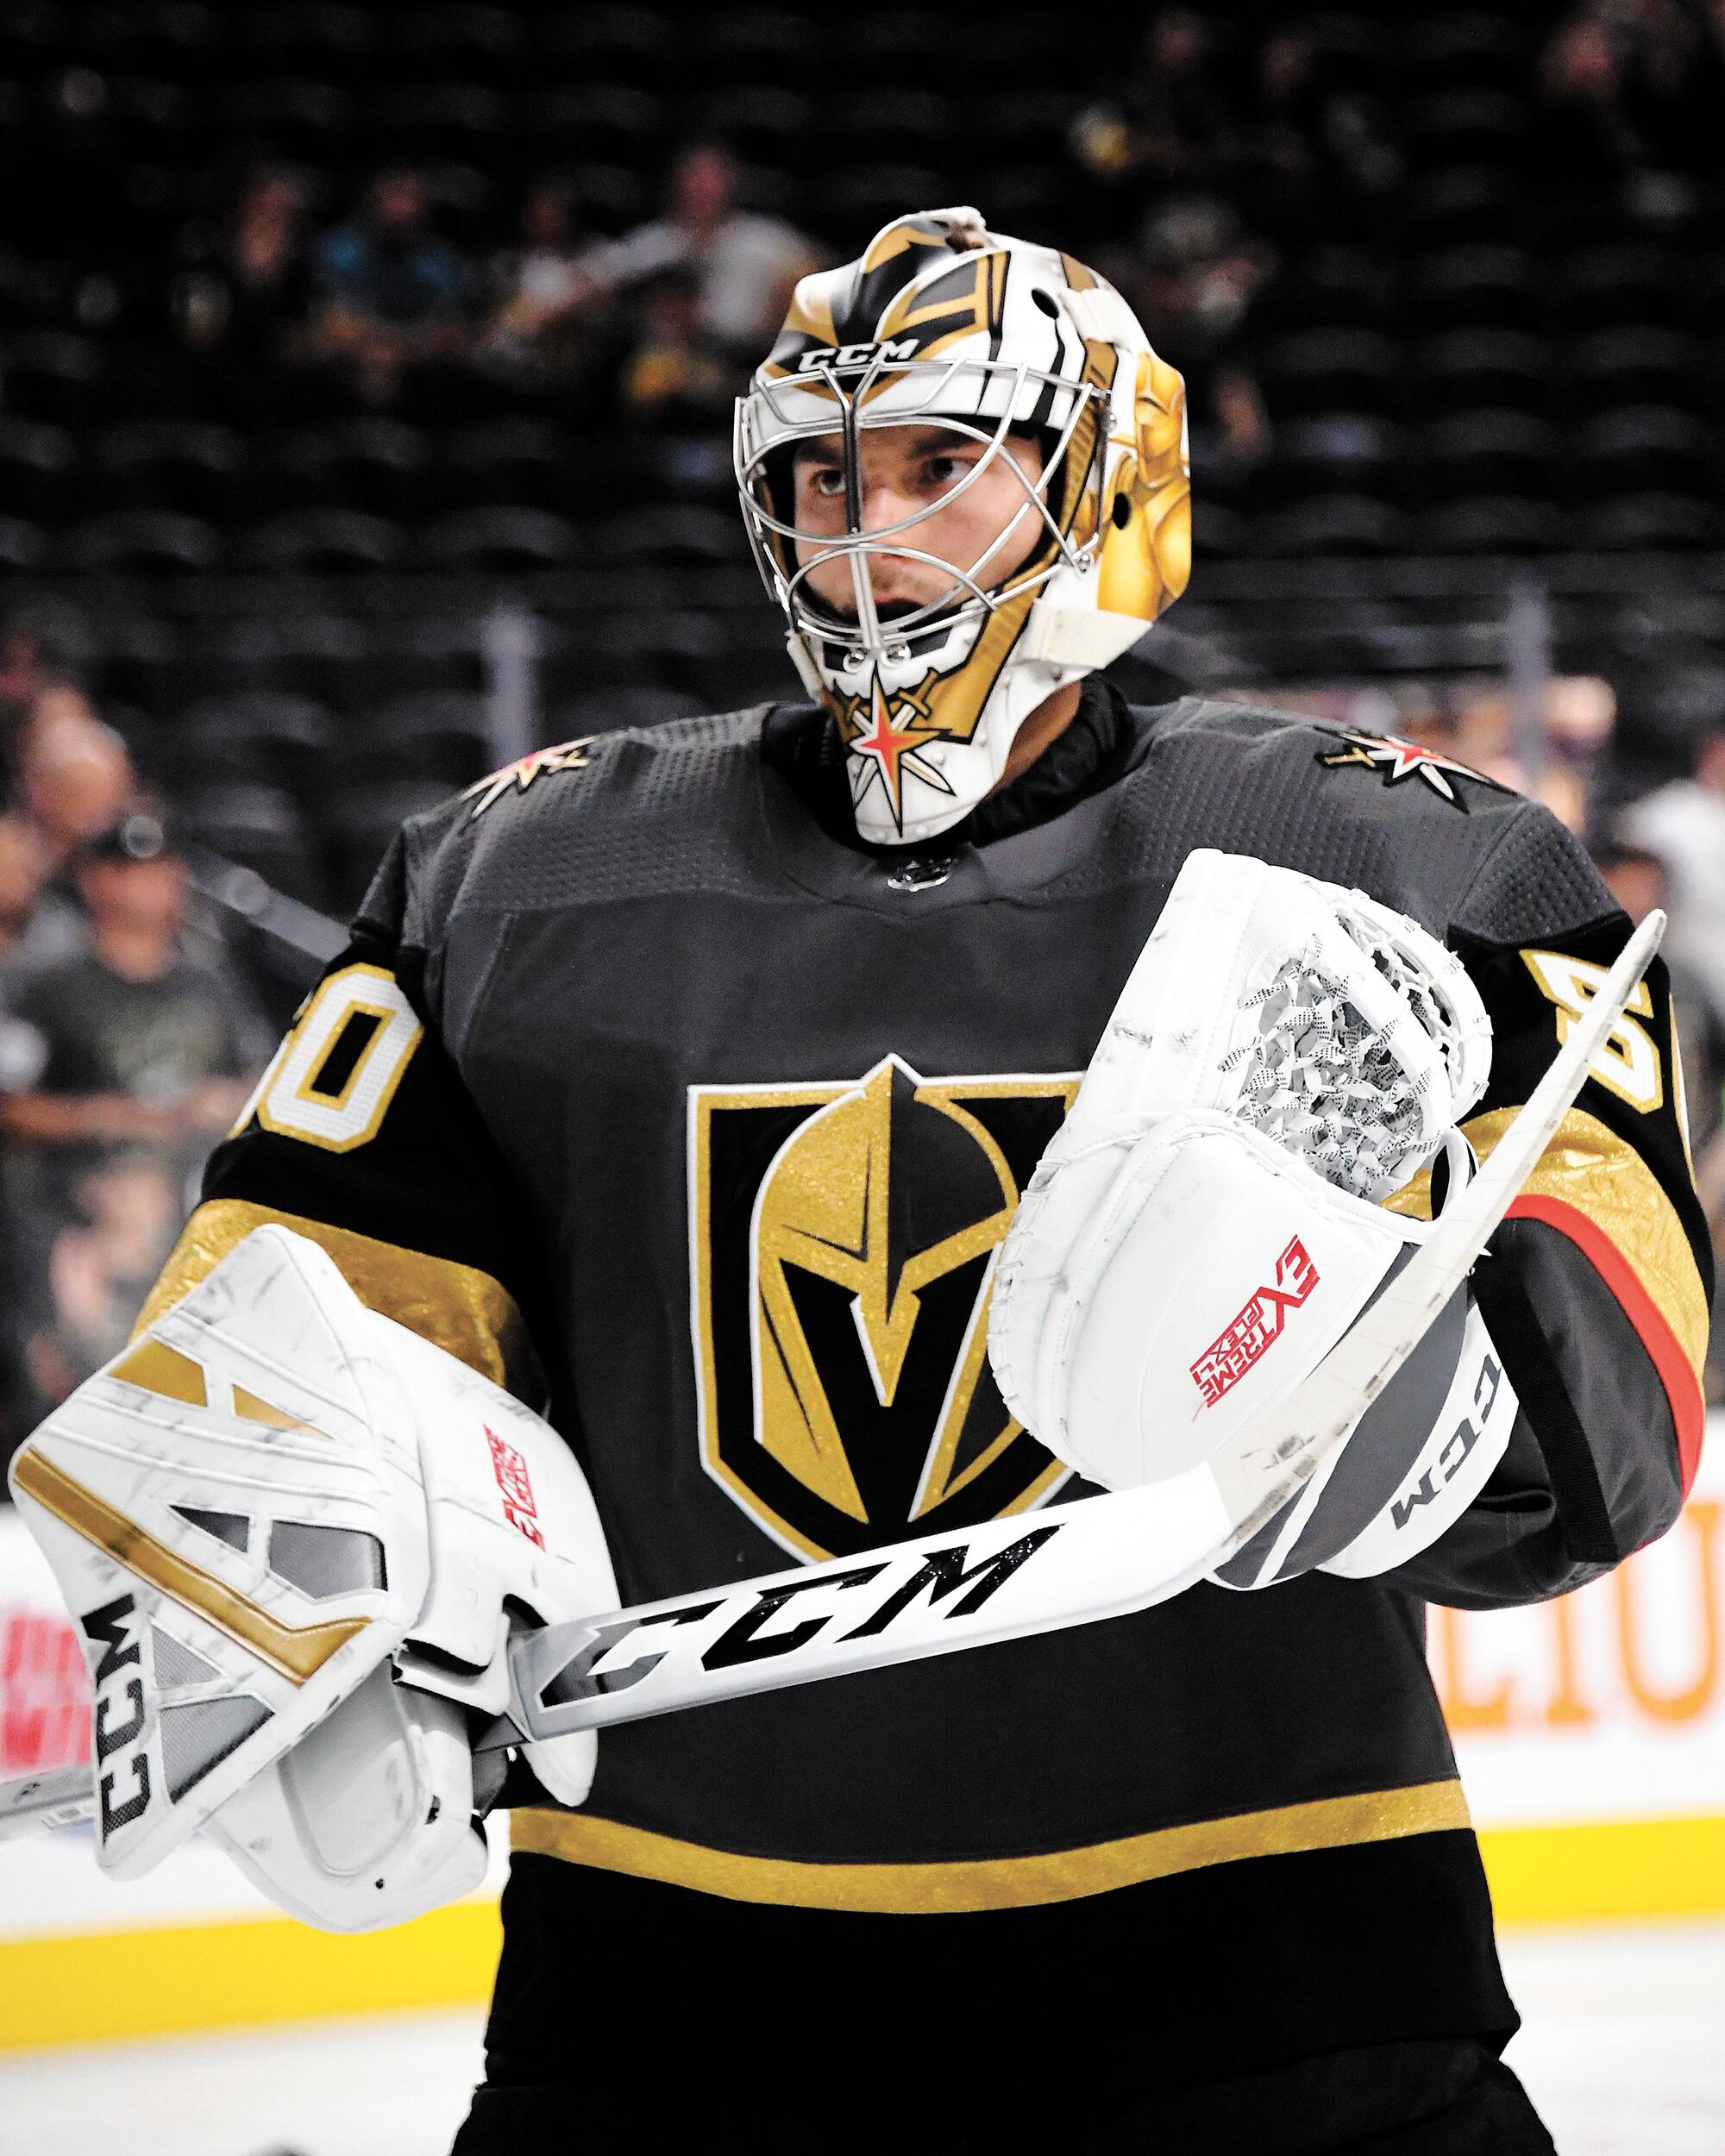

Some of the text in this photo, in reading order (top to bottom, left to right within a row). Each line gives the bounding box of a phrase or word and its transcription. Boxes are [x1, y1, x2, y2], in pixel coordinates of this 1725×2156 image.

[798, 338, 920, 373] CCM
[228, 962, 425, 1153] 0
[1389, 1353, 1502, 1531] CCM
[541, 1522, 1069, 1710] CCM
[81, 1593, 151, 1849] CCM
